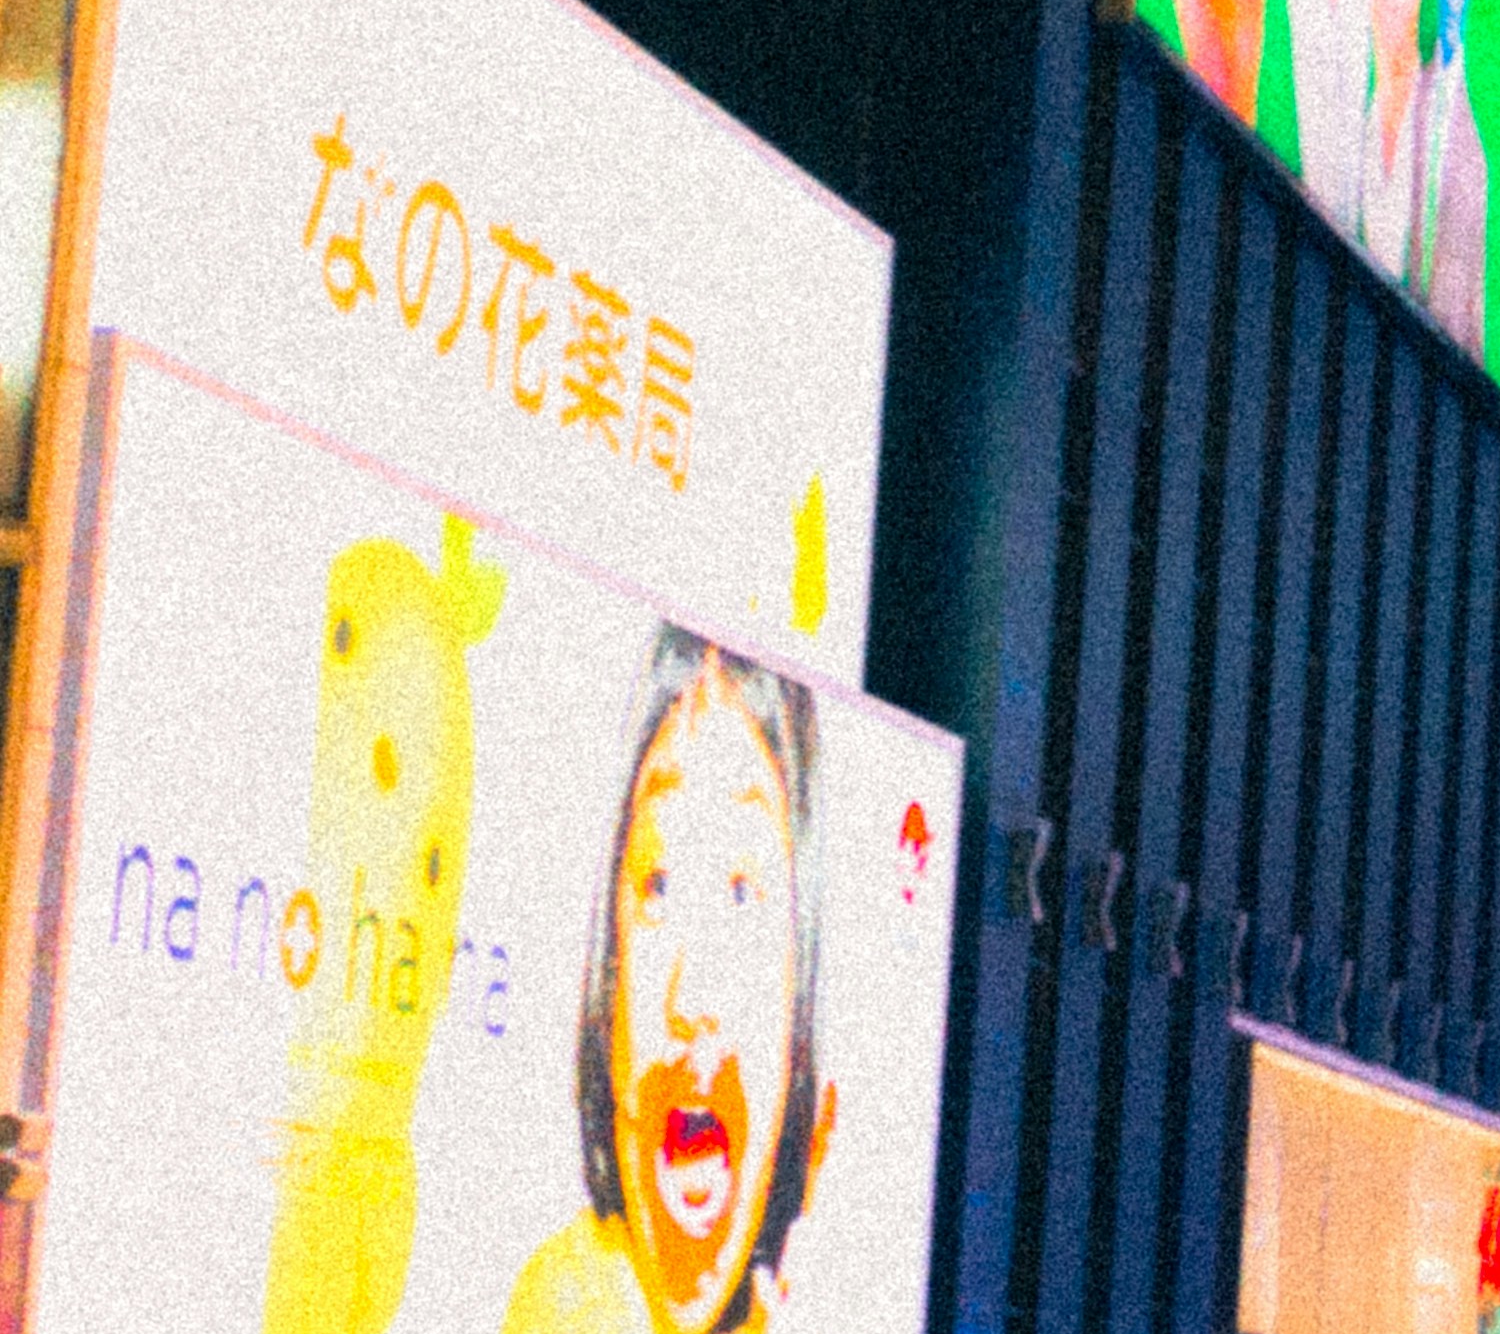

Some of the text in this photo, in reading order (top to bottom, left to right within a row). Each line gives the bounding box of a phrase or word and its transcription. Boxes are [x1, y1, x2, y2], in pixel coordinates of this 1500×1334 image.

[303, 114, 696, 495] なの花薬局
